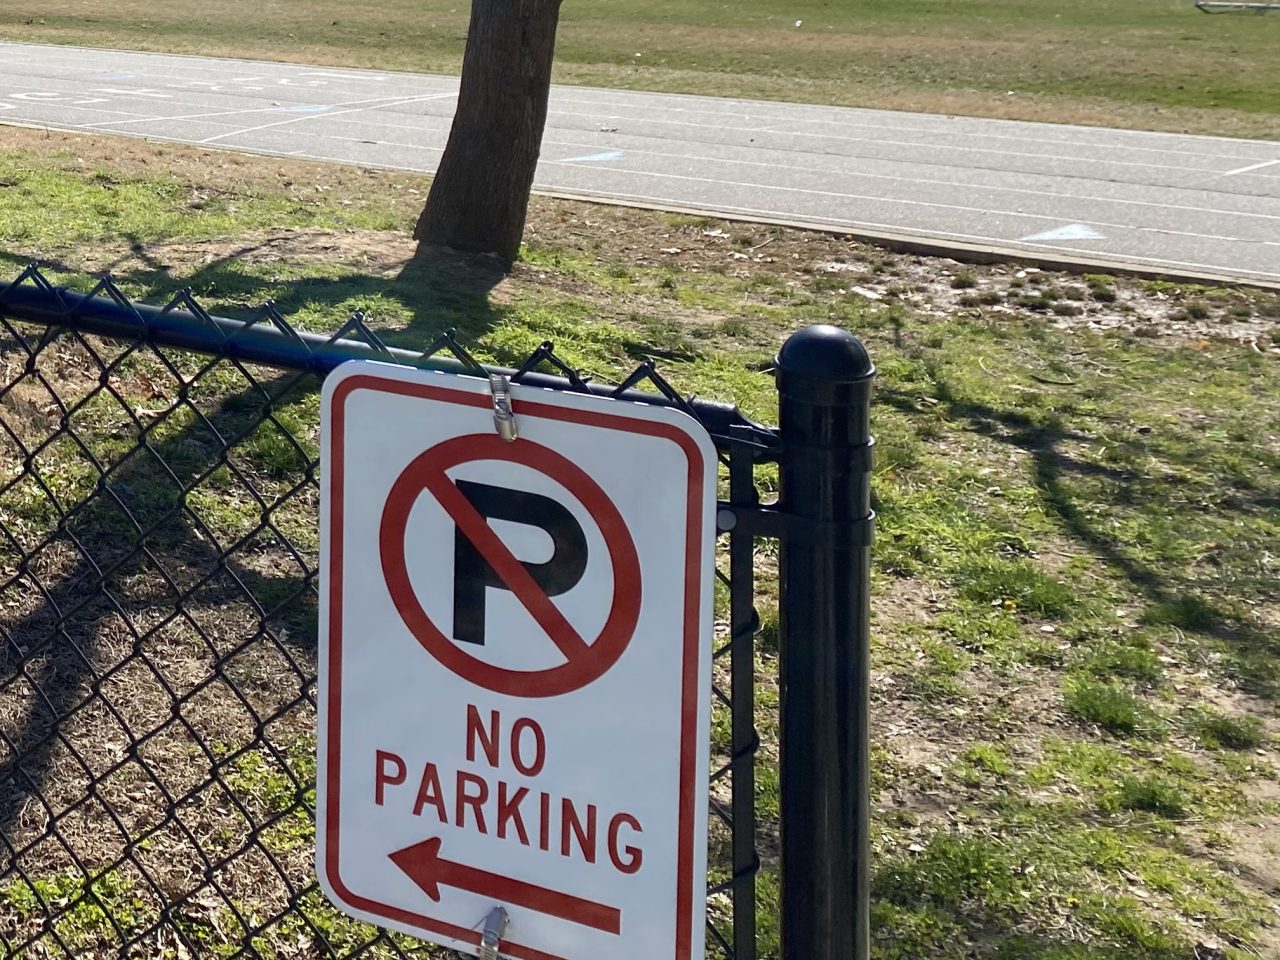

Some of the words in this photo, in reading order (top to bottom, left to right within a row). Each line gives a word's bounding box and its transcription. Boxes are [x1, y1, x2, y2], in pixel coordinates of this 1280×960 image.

[8, 91, 111, 105] 5
[453, 479, 589, 646] P
[466, 704, 546, 777] NO
[375, 749, 643, 874] PARKING
